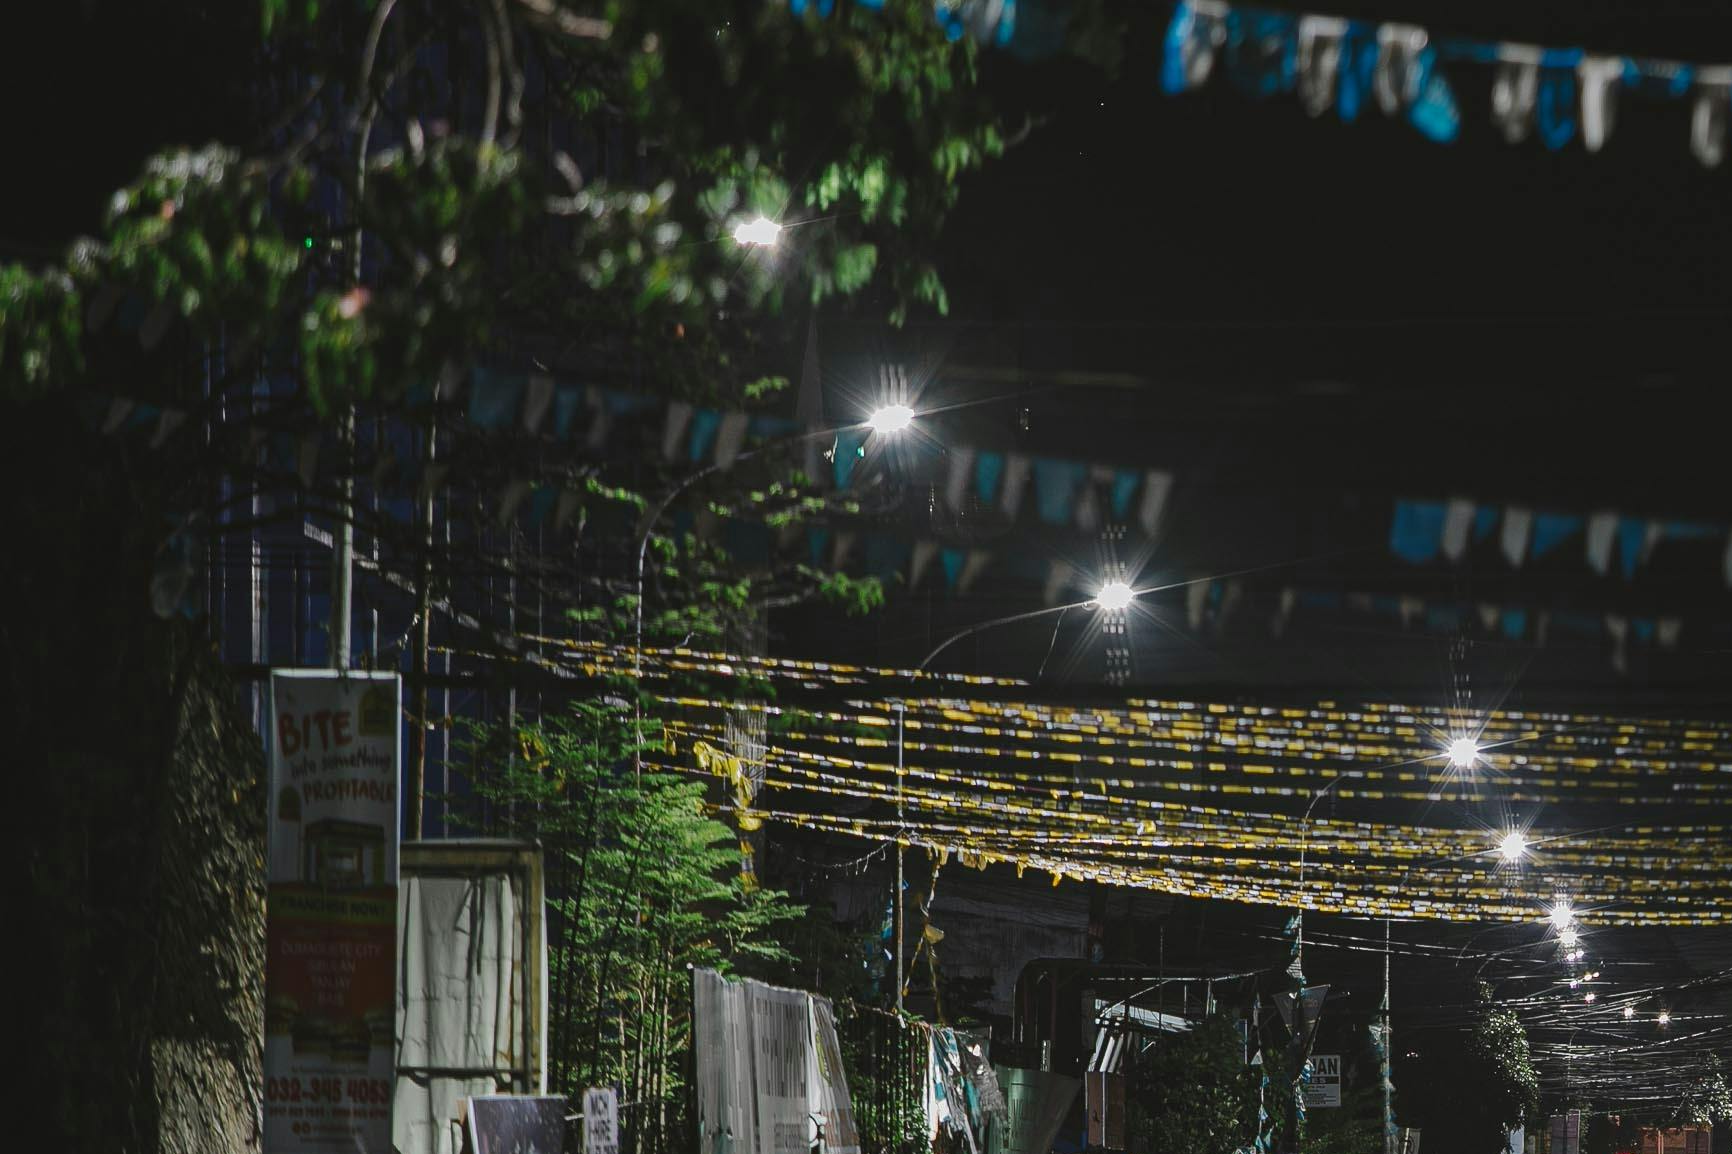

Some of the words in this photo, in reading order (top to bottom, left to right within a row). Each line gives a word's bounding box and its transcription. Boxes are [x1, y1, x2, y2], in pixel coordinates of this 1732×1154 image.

[278, 709, 353, 760] BITE
[321, 744, 391, 774] something
[303, 779, 396, 806] PROFITABLE
